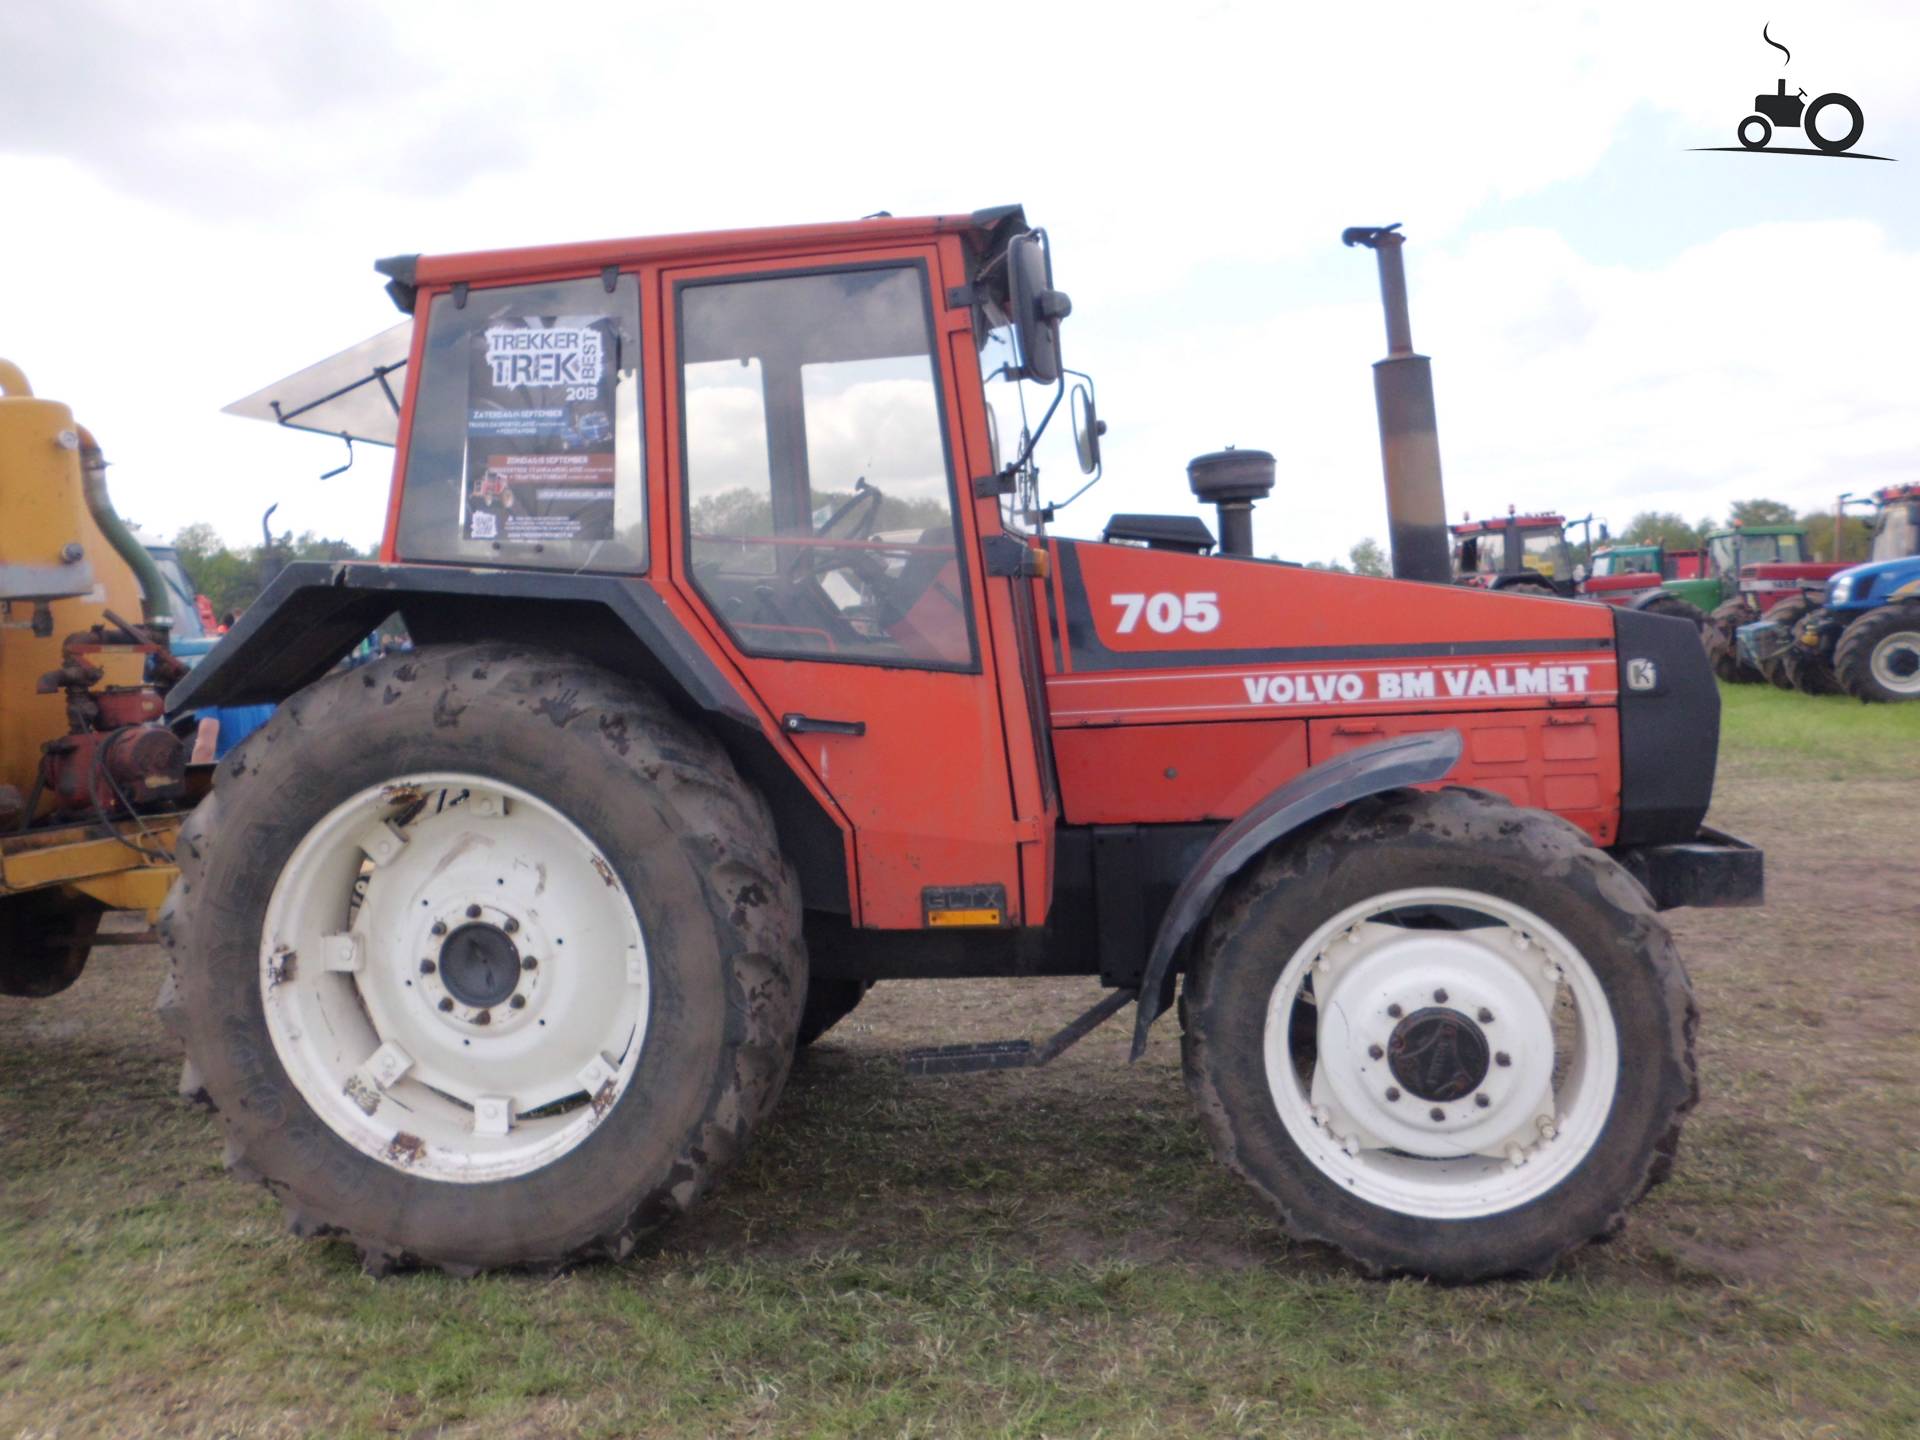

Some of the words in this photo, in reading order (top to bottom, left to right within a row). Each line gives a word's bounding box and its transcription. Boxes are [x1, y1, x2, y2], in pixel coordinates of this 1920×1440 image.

[491, 332, 579, 351] TREKKER
[581, 333, 598, 379] BEST
[492, 353, 578, 383] TREK
[565, 387, 598, 401] 2013
[1110, 592, 1221, 634] 705
[1243, 673, 1364, 704] VOLVO
[1377, 671, 1435, 699] BM
[1441, 665, 1589, 697] VALMET
